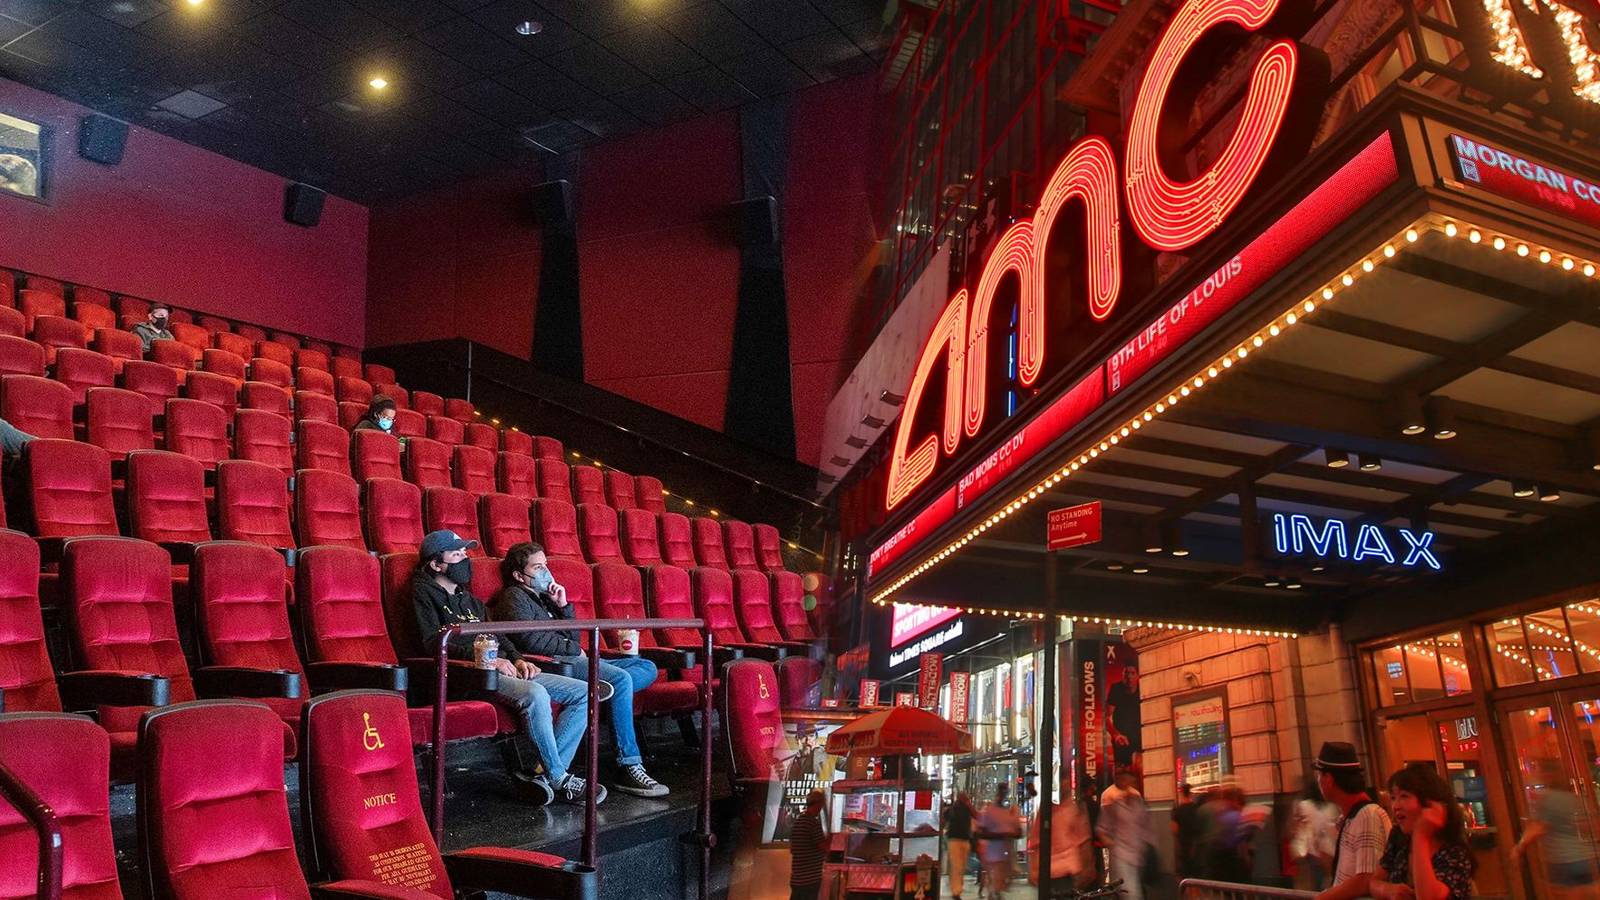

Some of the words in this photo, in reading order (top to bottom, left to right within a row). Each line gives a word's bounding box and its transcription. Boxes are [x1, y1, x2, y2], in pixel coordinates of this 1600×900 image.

[1454, 134, 1569, 192] MORGAN
[1111, 342, 1135, 372] 9TH
[1137, 315, 1167, 351] LIFE
[1169, 297, 1190, 325] OF
[1192, 255, 1243, 307] LOUIS
[959, 471, 974, 493] BAD
[975, 452, 998, 481] MOMS
[999, 441, 1012, 460] CC
[1012, 430, 1025, 450] DV
[1051, 514, 1060, 523] NO
[1061, 507, 1093, 521] STANDING
[1051, 521, 1078, 532] Anytime
[1274, 513, 1442, 570] IMAX
[956, 673, 966, 723] MODELL'S
[1084, 660, 1096, 728] FOLLOWS
[363, 792, 398, 810] NOTICE
